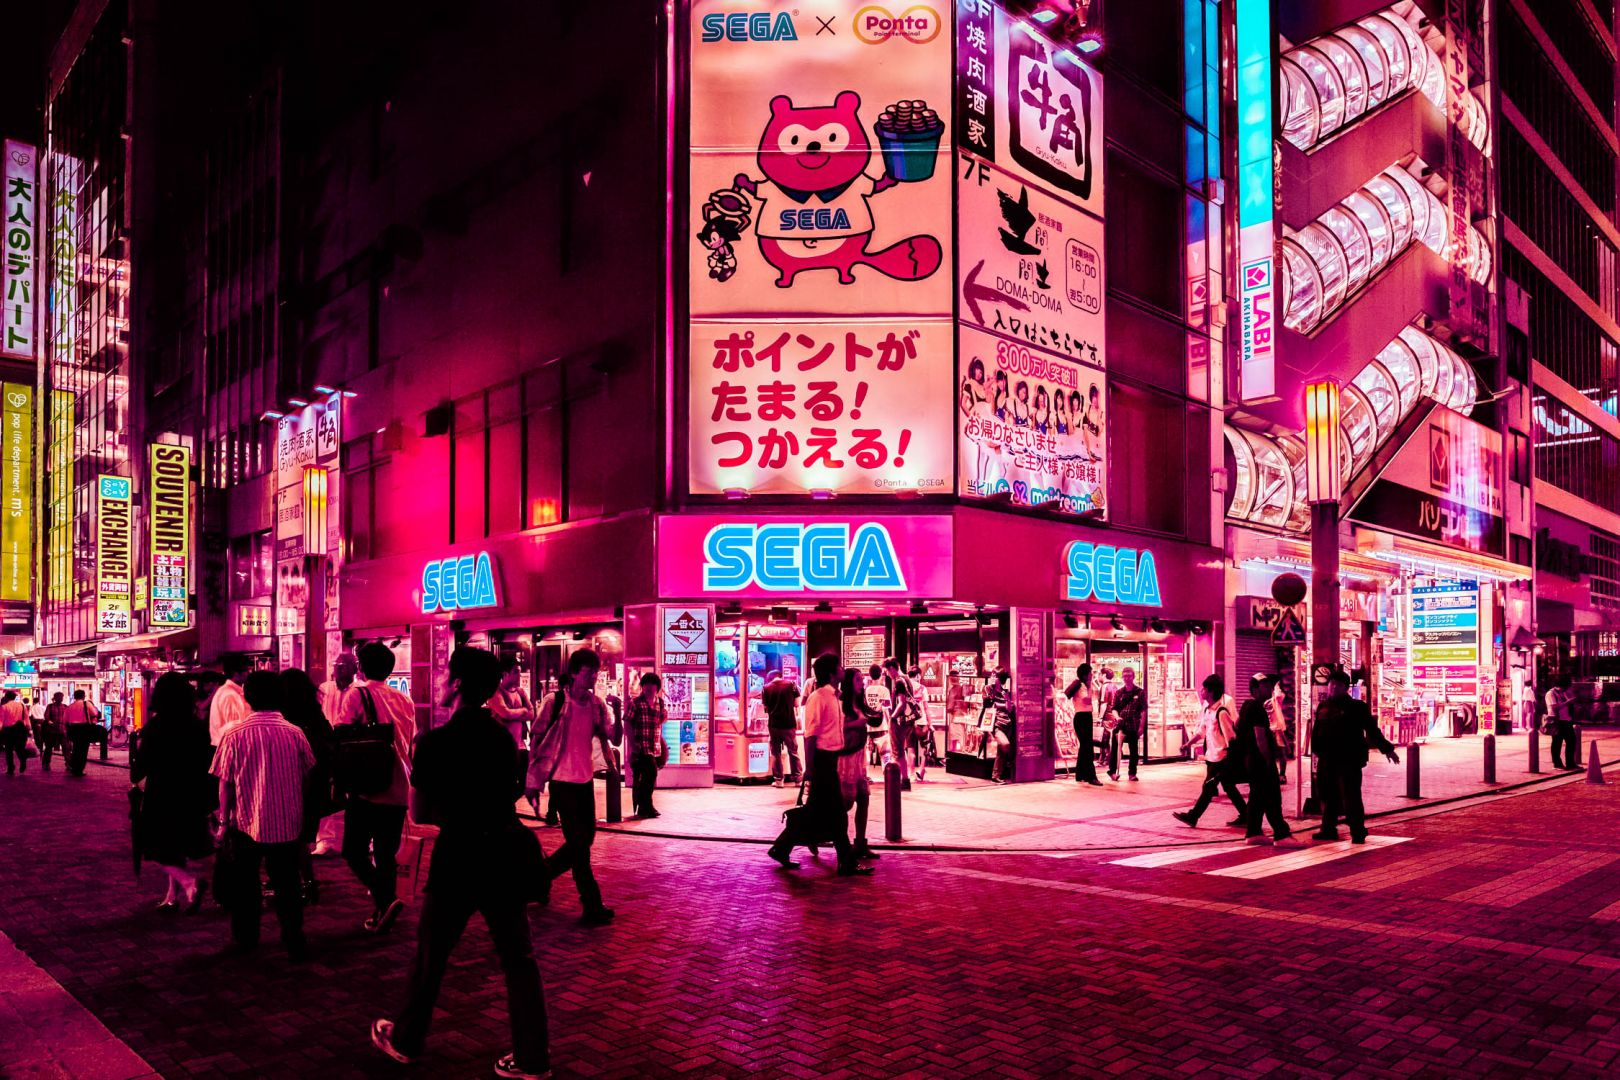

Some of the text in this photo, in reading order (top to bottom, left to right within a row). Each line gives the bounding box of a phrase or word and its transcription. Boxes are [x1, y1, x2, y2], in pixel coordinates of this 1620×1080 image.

[702, 12, 798, 42] SEGA
[866, 16, 928, 31] Ponta
[967, 21, 987, 148] 焼肉酒家
[1021, 63, 1083, 167] 牛角
[961, 154, 990, 186] 7F
[1036, 146, 1067, 170] Gyu-Kaku
[780, 208, 851, 230] SEGA
[8, 177, 31, 350] 大人のデパート
[1070, 257, 1096, 279] 16:00
[996, 277, 1063, 314] DOMA-DOMA
[1243, 297, 1251, 361] AKIHABARA
[1253, 292, 1271, 355] LABI
[712, 329, 921, 372] ポイントが
[711, 380, 869, 422] たまる!
[711, 427, 912, 469] つかえる!
[968, 417, 1057, 455] お帰りなさいませ
[11, 413, 23, 517] pop life department. m's
[279, 449, 314, 473] Gyu-Kaku
[155, 448, 185, 552] SOUVENIR
[102, 499, 128, 580] EXCHANGE
[703, 522, 908, 591] SEGA
[422, 550, 498, 614] SEGA
[1067, 540, 1163, 608] SEGA
[102, 620, 127, 629] 太郎
